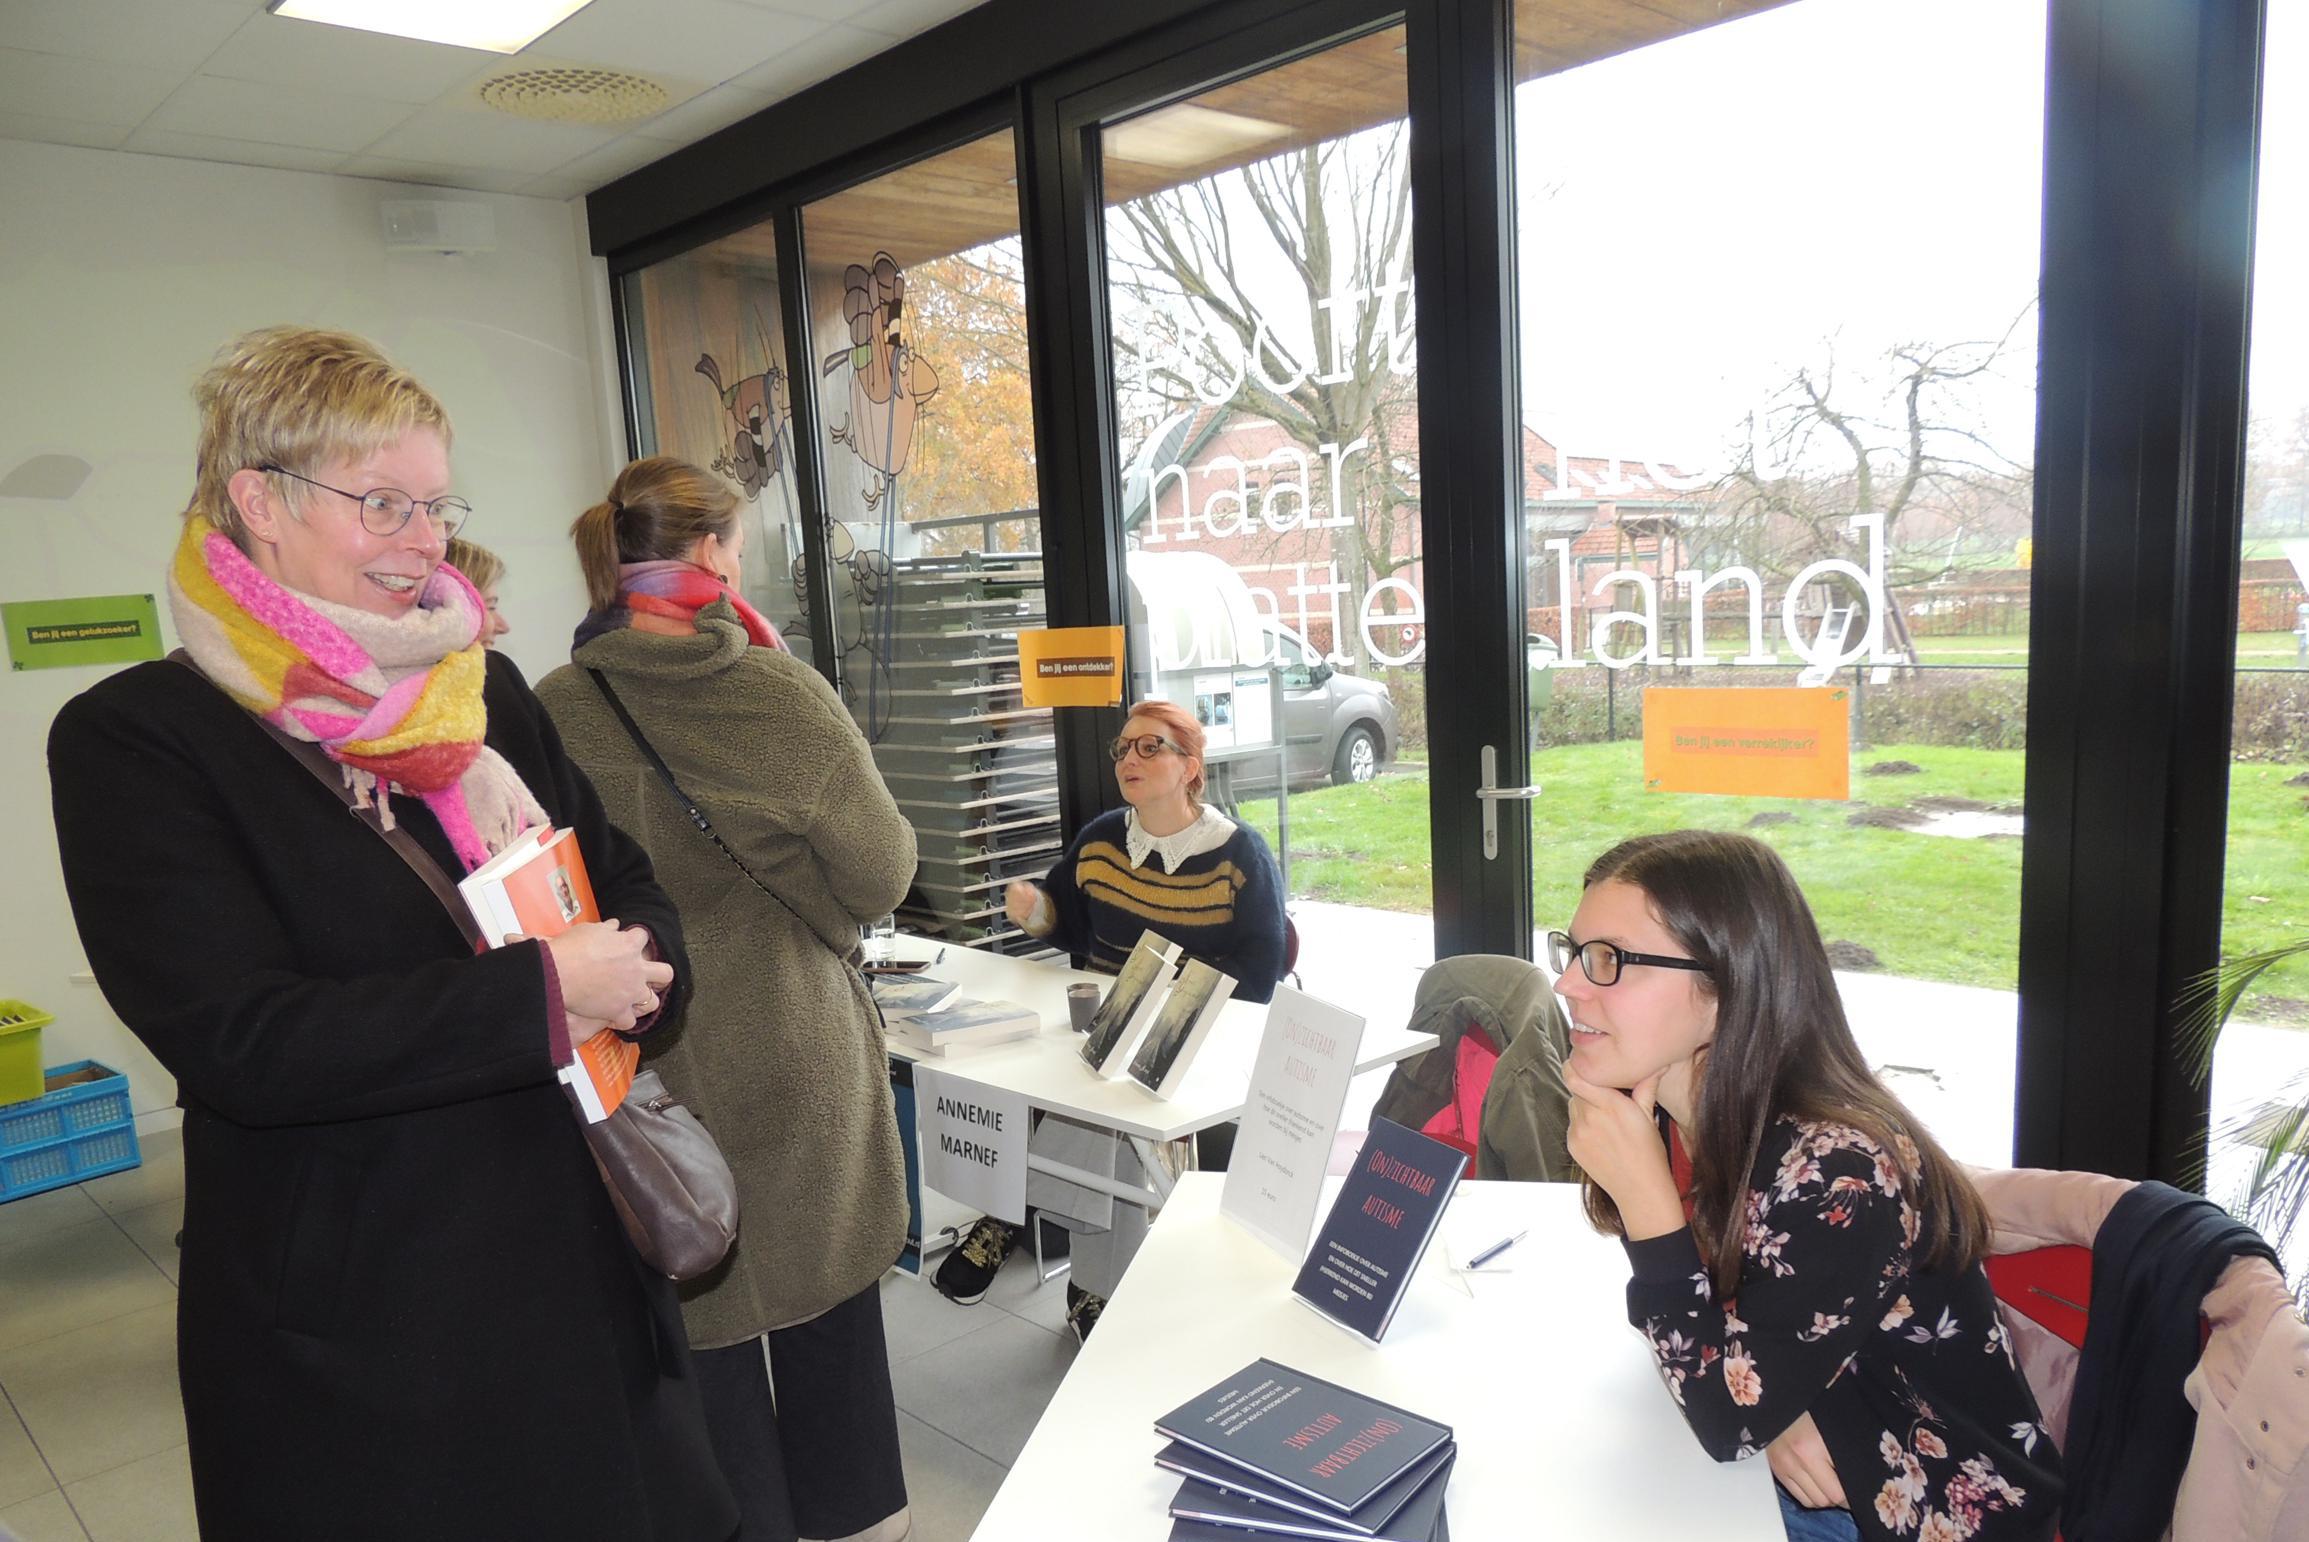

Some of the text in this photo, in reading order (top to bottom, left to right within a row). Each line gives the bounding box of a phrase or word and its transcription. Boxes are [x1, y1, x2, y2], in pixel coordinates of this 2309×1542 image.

[1141, 436, 1369, 544] naar
[1545, 513, 1903, 669] land
[31, 630, 50, 639] Ben
[60, 628, 78, 637] een
[78, 624, 137, 637] gelukzoeker?
[1039, 664, 1053, 673] Ben
[1062, 664, 1077, 672] een
[1078, 662, 1113, 672] ontdekker?
[1675, 735, 1697, 747] Ben
[1712, 738, 1735, 748] een
[937, 1096, 1003, 1132] ANNEMIE
[940, 1133, 998, 1168] MARNEF
[1366, 1148, 1436, 1197] (ON)ZICHTBAAR
[1361, 1194, 1405, 1230] AUTISME
[1282, 1412, 1342, 1450] AUTISME
